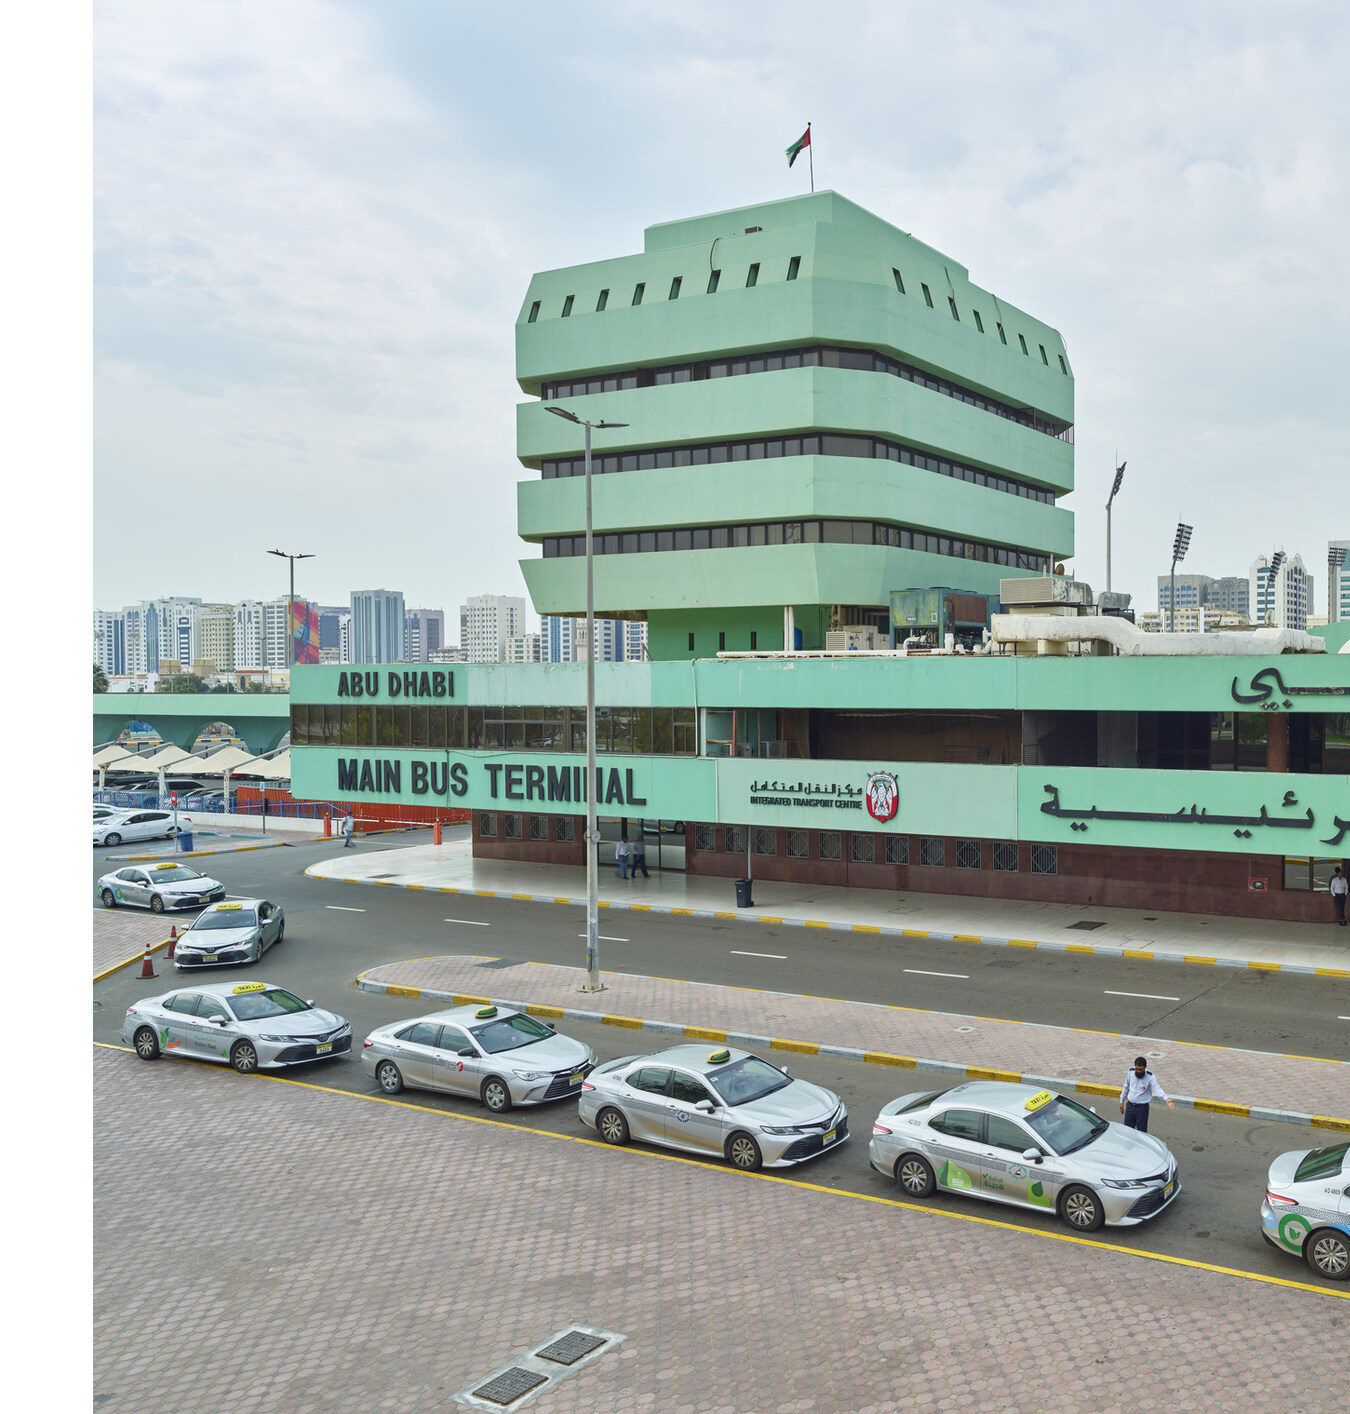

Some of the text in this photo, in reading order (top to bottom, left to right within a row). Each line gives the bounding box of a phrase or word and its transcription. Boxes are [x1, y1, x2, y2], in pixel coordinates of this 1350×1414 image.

[338, 671, 455, 698] ABU DHABI
[337, 758, 401, 793] MAIN
[411, 760, 469, 797] BUS
[750, 780, 862, 798] مركز النقل المتكامل
[750, 796, 863, 810] INTEGRATED TRANSPORT CENTRE
